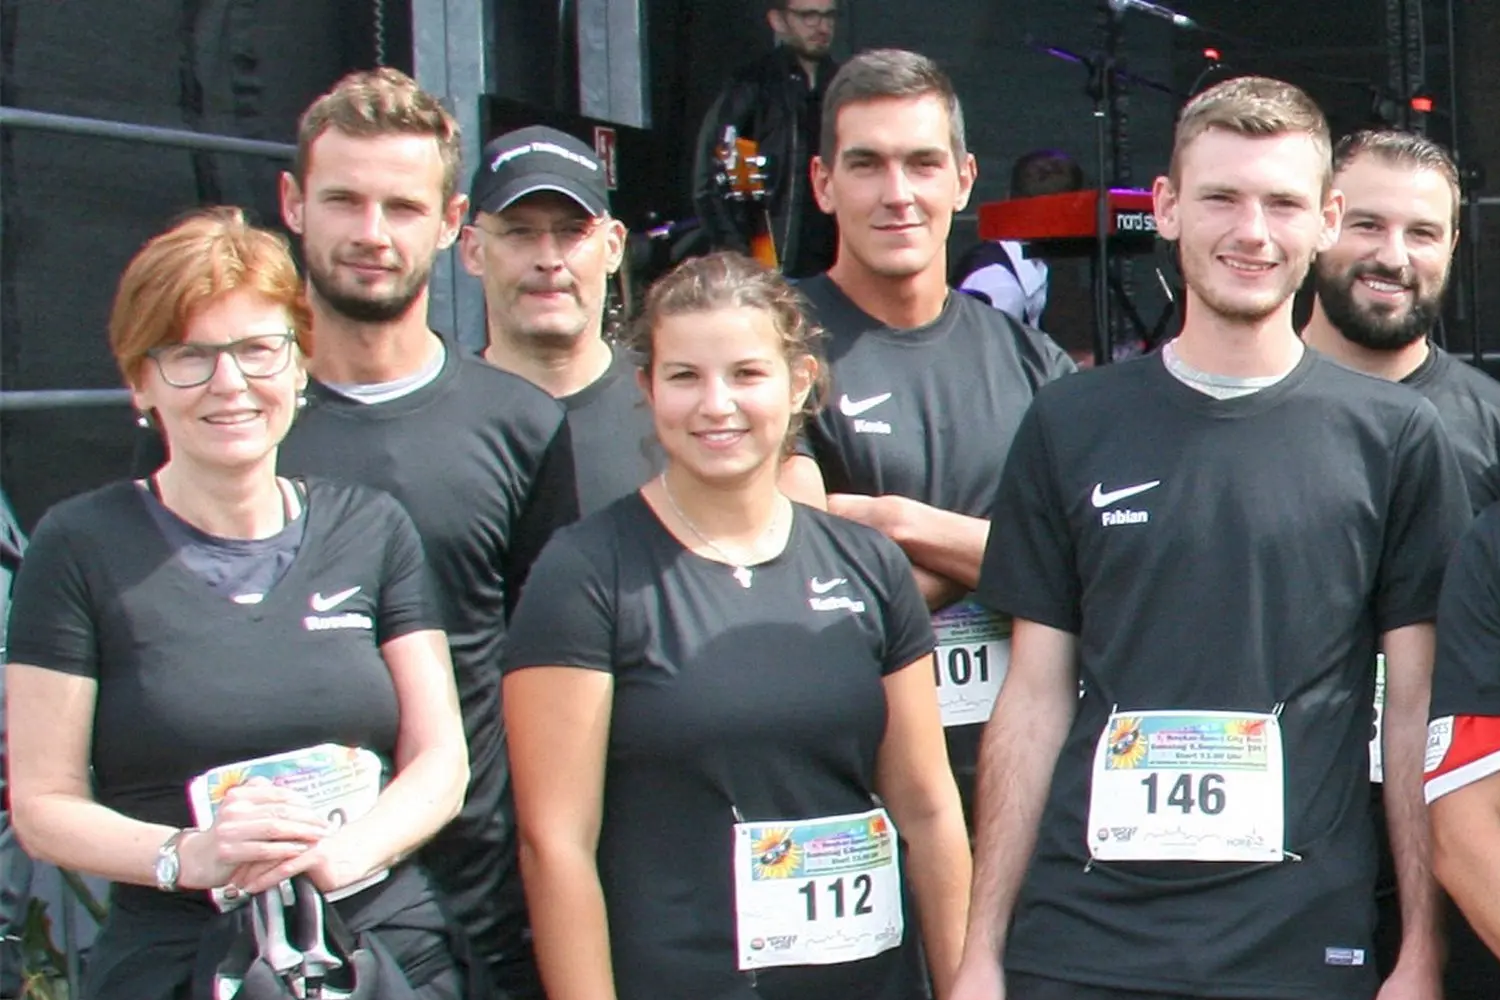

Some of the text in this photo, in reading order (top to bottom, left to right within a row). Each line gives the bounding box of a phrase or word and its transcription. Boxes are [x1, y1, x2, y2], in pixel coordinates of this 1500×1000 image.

[1102, 509, 1149, 527] Fabian
[1141, 772, 1226, 815] 146
[798, 873, 873, 921] 112
